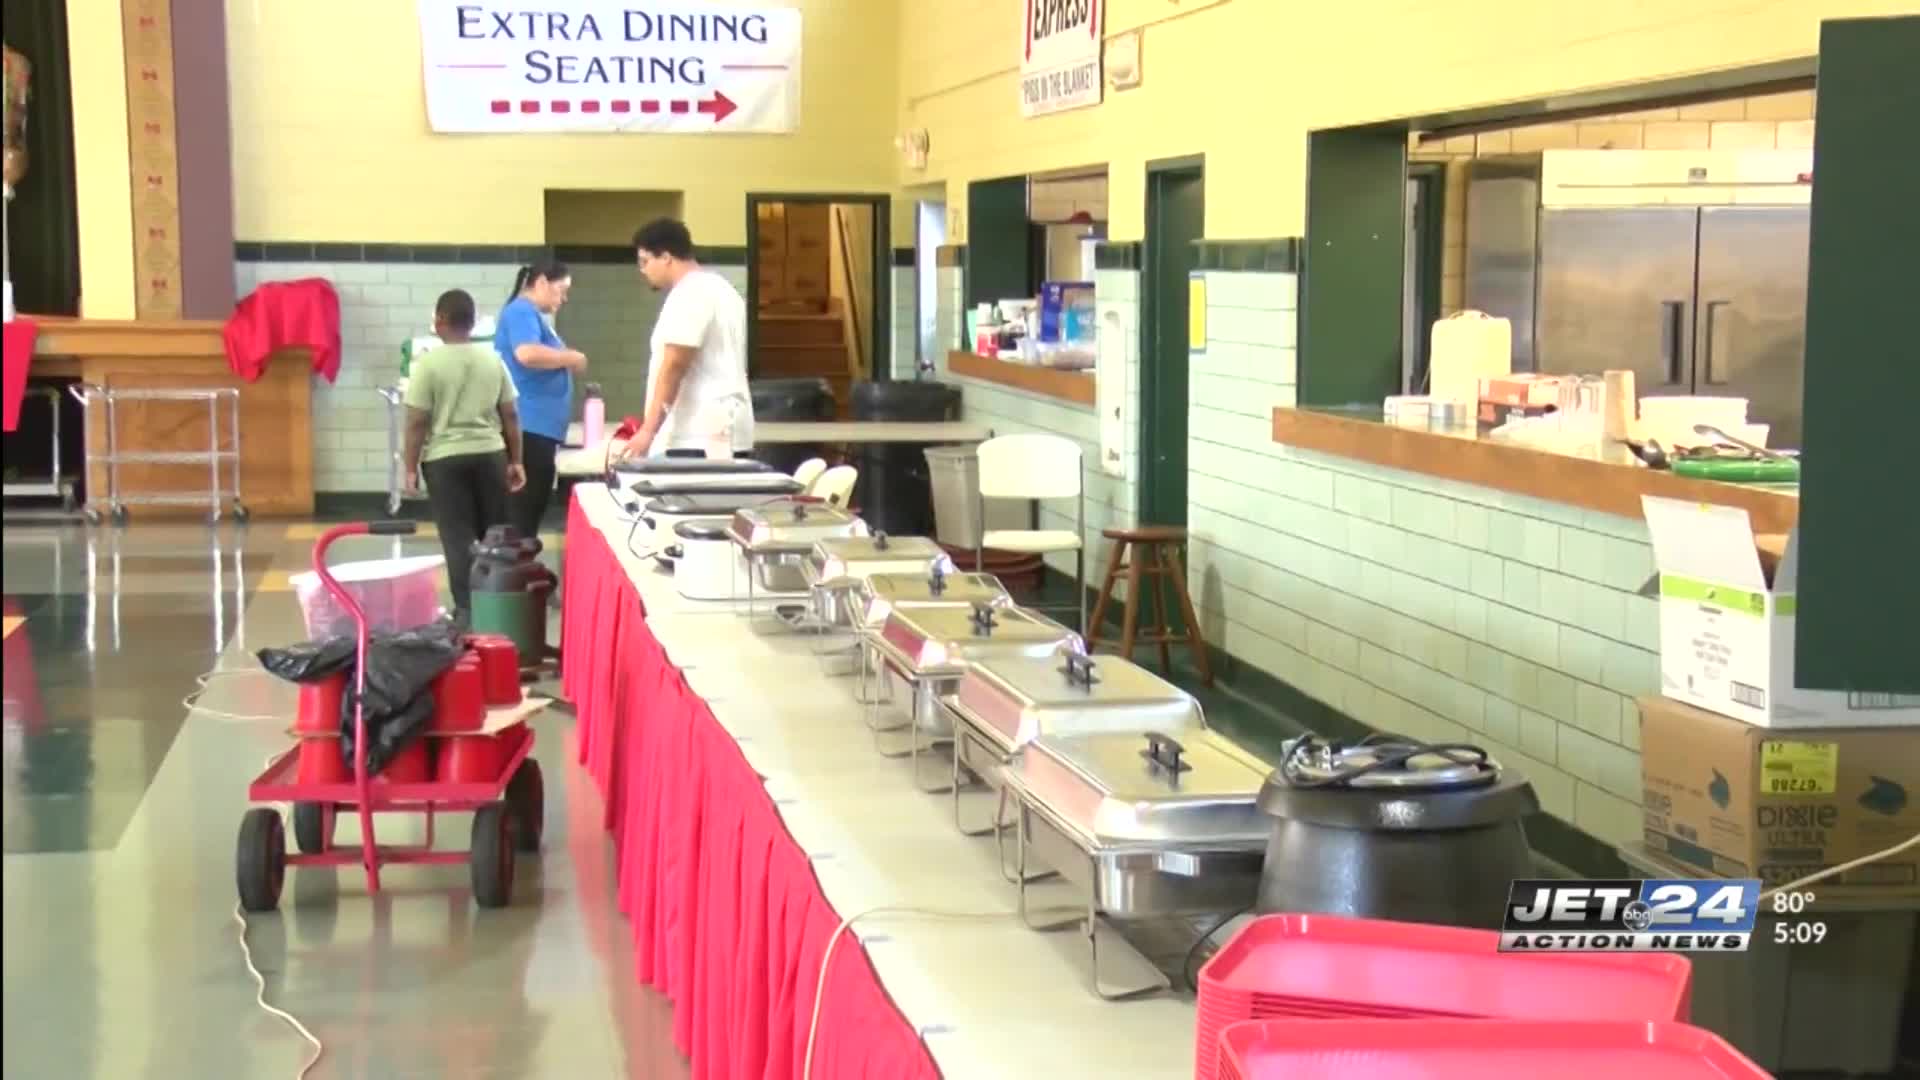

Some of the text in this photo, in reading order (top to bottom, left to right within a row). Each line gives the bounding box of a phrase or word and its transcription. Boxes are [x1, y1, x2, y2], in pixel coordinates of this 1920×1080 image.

[456, 5, 768, 43] EXTRA DINING
[1033, 0, 1088, 40] EXPRESS
[525, 50, 706, 85] SEATING
